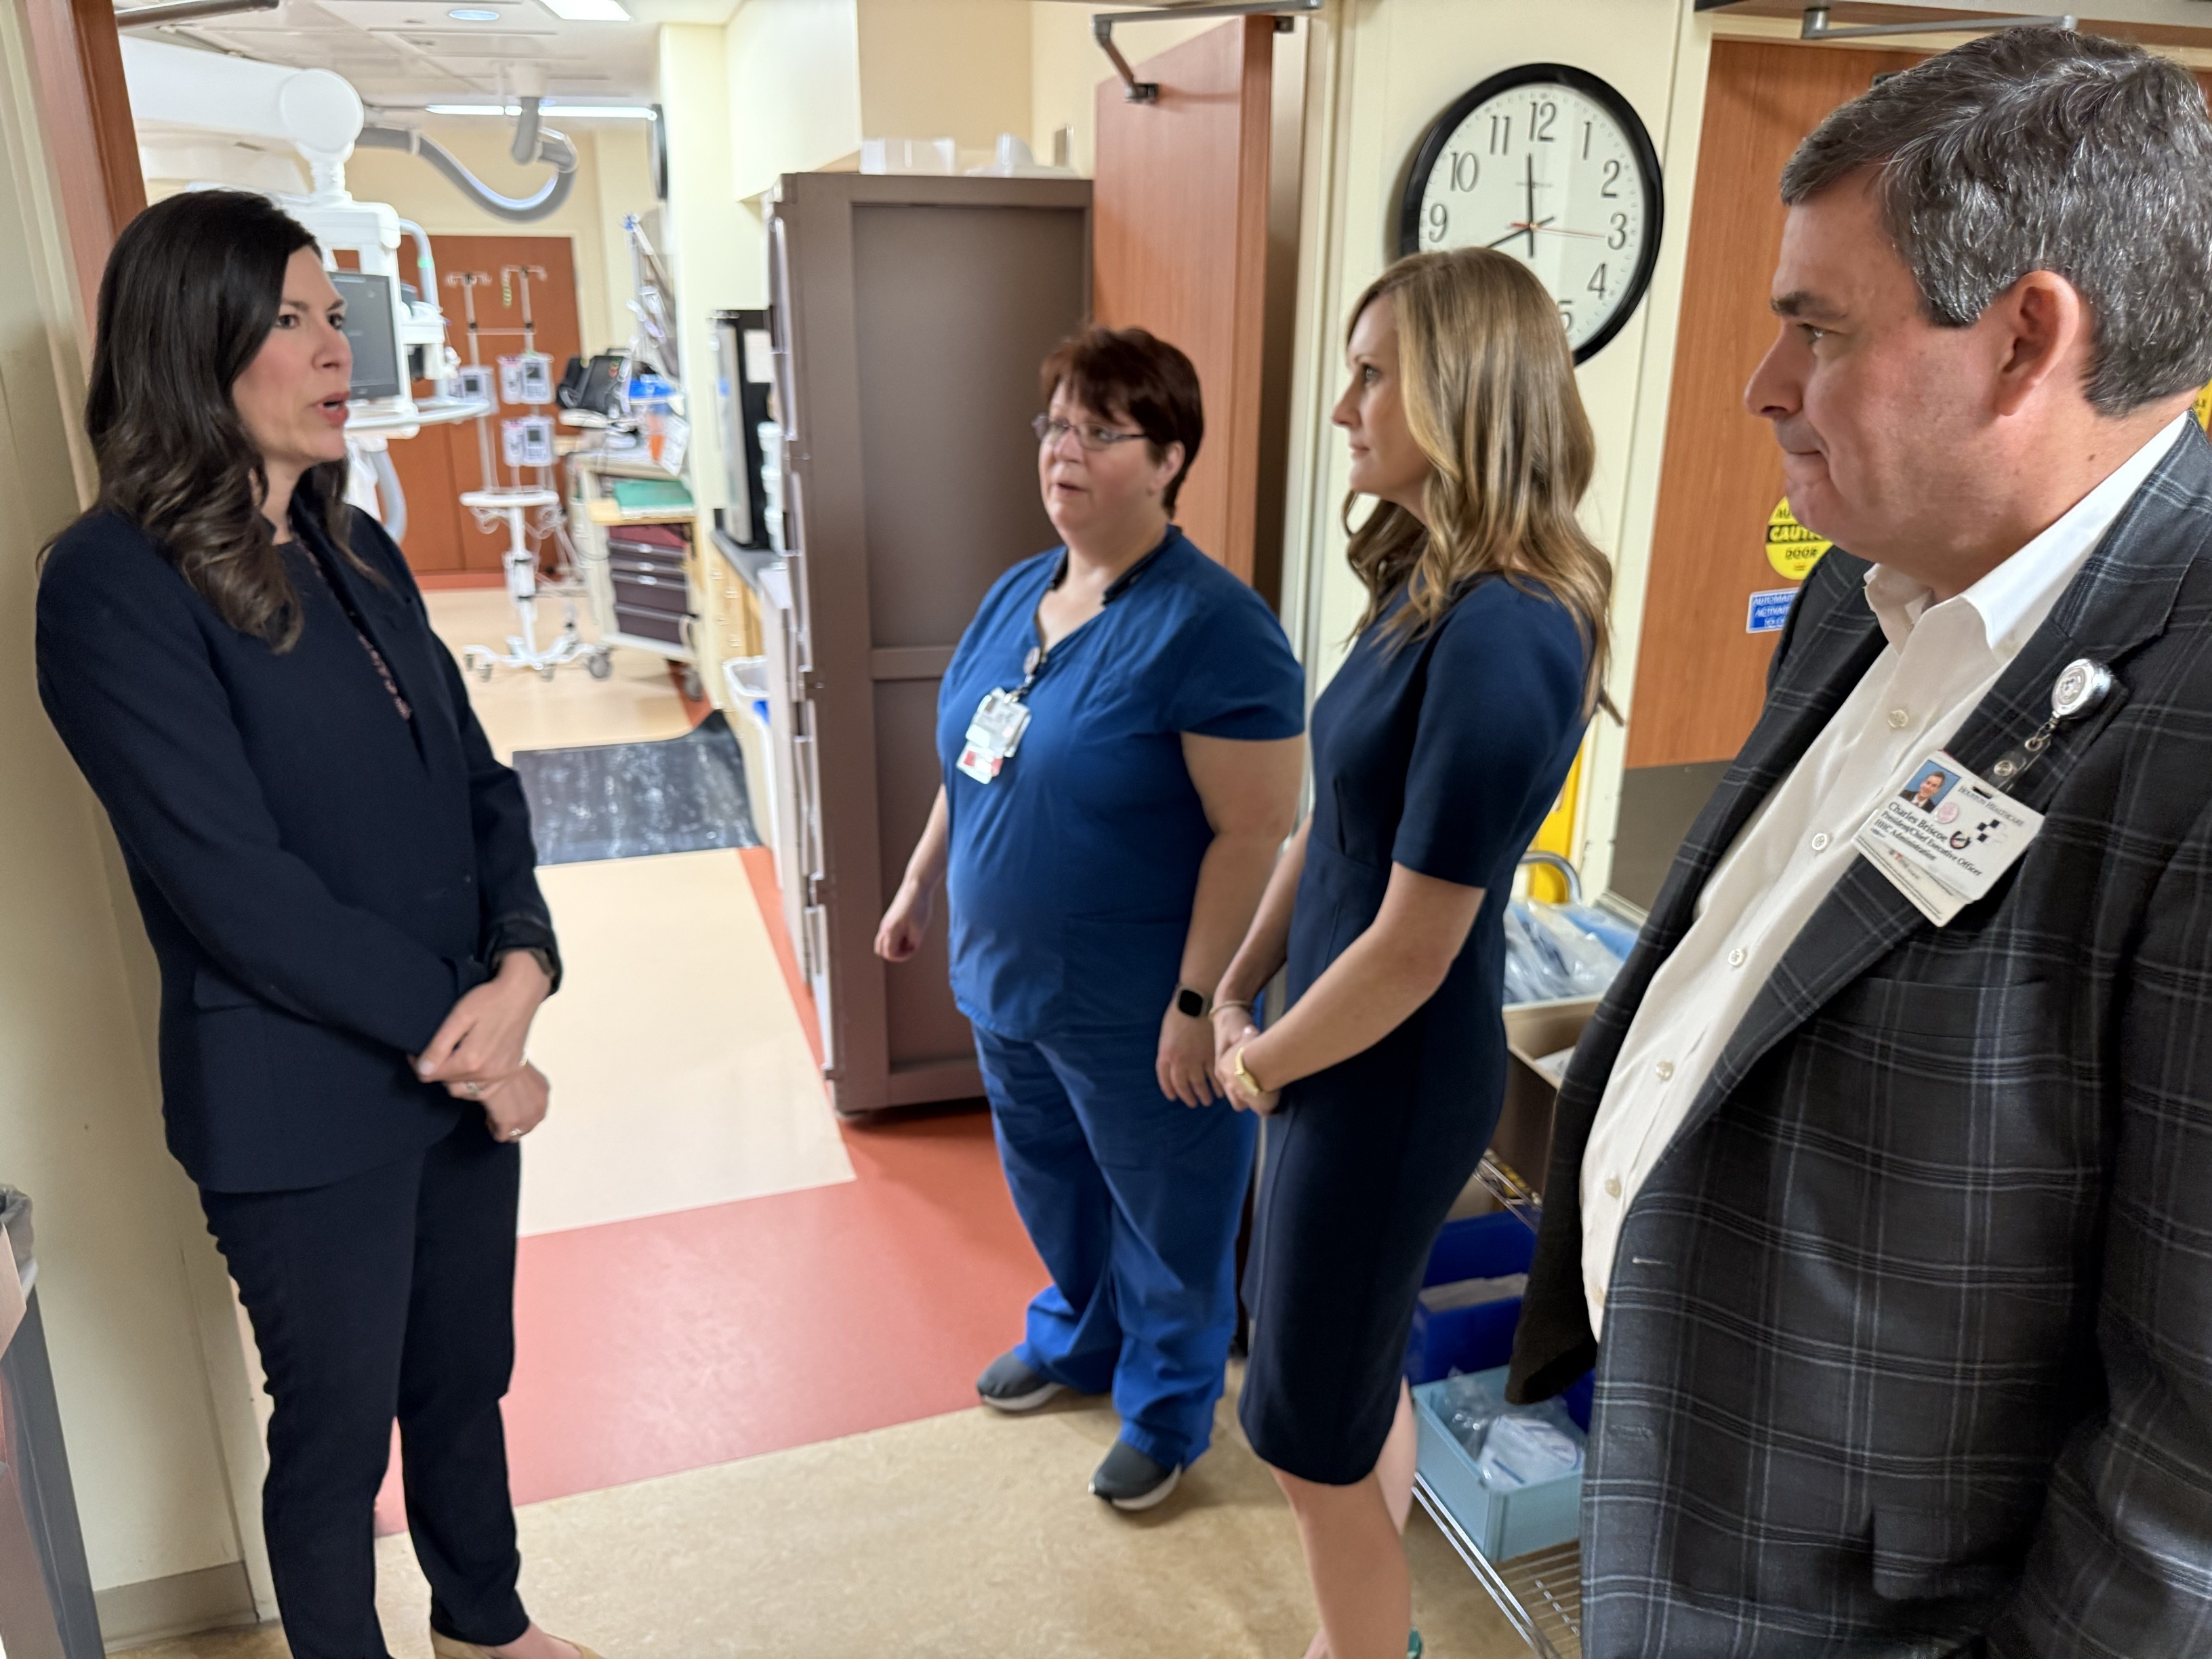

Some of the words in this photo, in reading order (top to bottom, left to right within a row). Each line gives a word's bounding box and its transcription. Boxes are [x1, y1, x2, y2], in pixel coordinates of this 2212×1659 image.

[1490, 115, 1511, 156] 11
[1530, 102, 1557, 142] 12
[1582, 121, 1593, 161] 1
[1449, 152, 1479, 192] 10
[1601, 159, 1620, 199] 2
[1429, 203, 1448, 243] 9
[1607, 212, 1626, 250] 3
[1587, 262, 1607, 300] 4
[1785, 547, 1818, 560] DOOR
[1875, 819, 1892, 832] HHC
[1890, 829, 1936, 861] Administration
[1889, 802, 1917, 823] Charles
[1918, 820, 1948, 842] Briscoe
[1928, 839, 1957, 861] Executive
[1957, 858, 1982, 876] Officer
